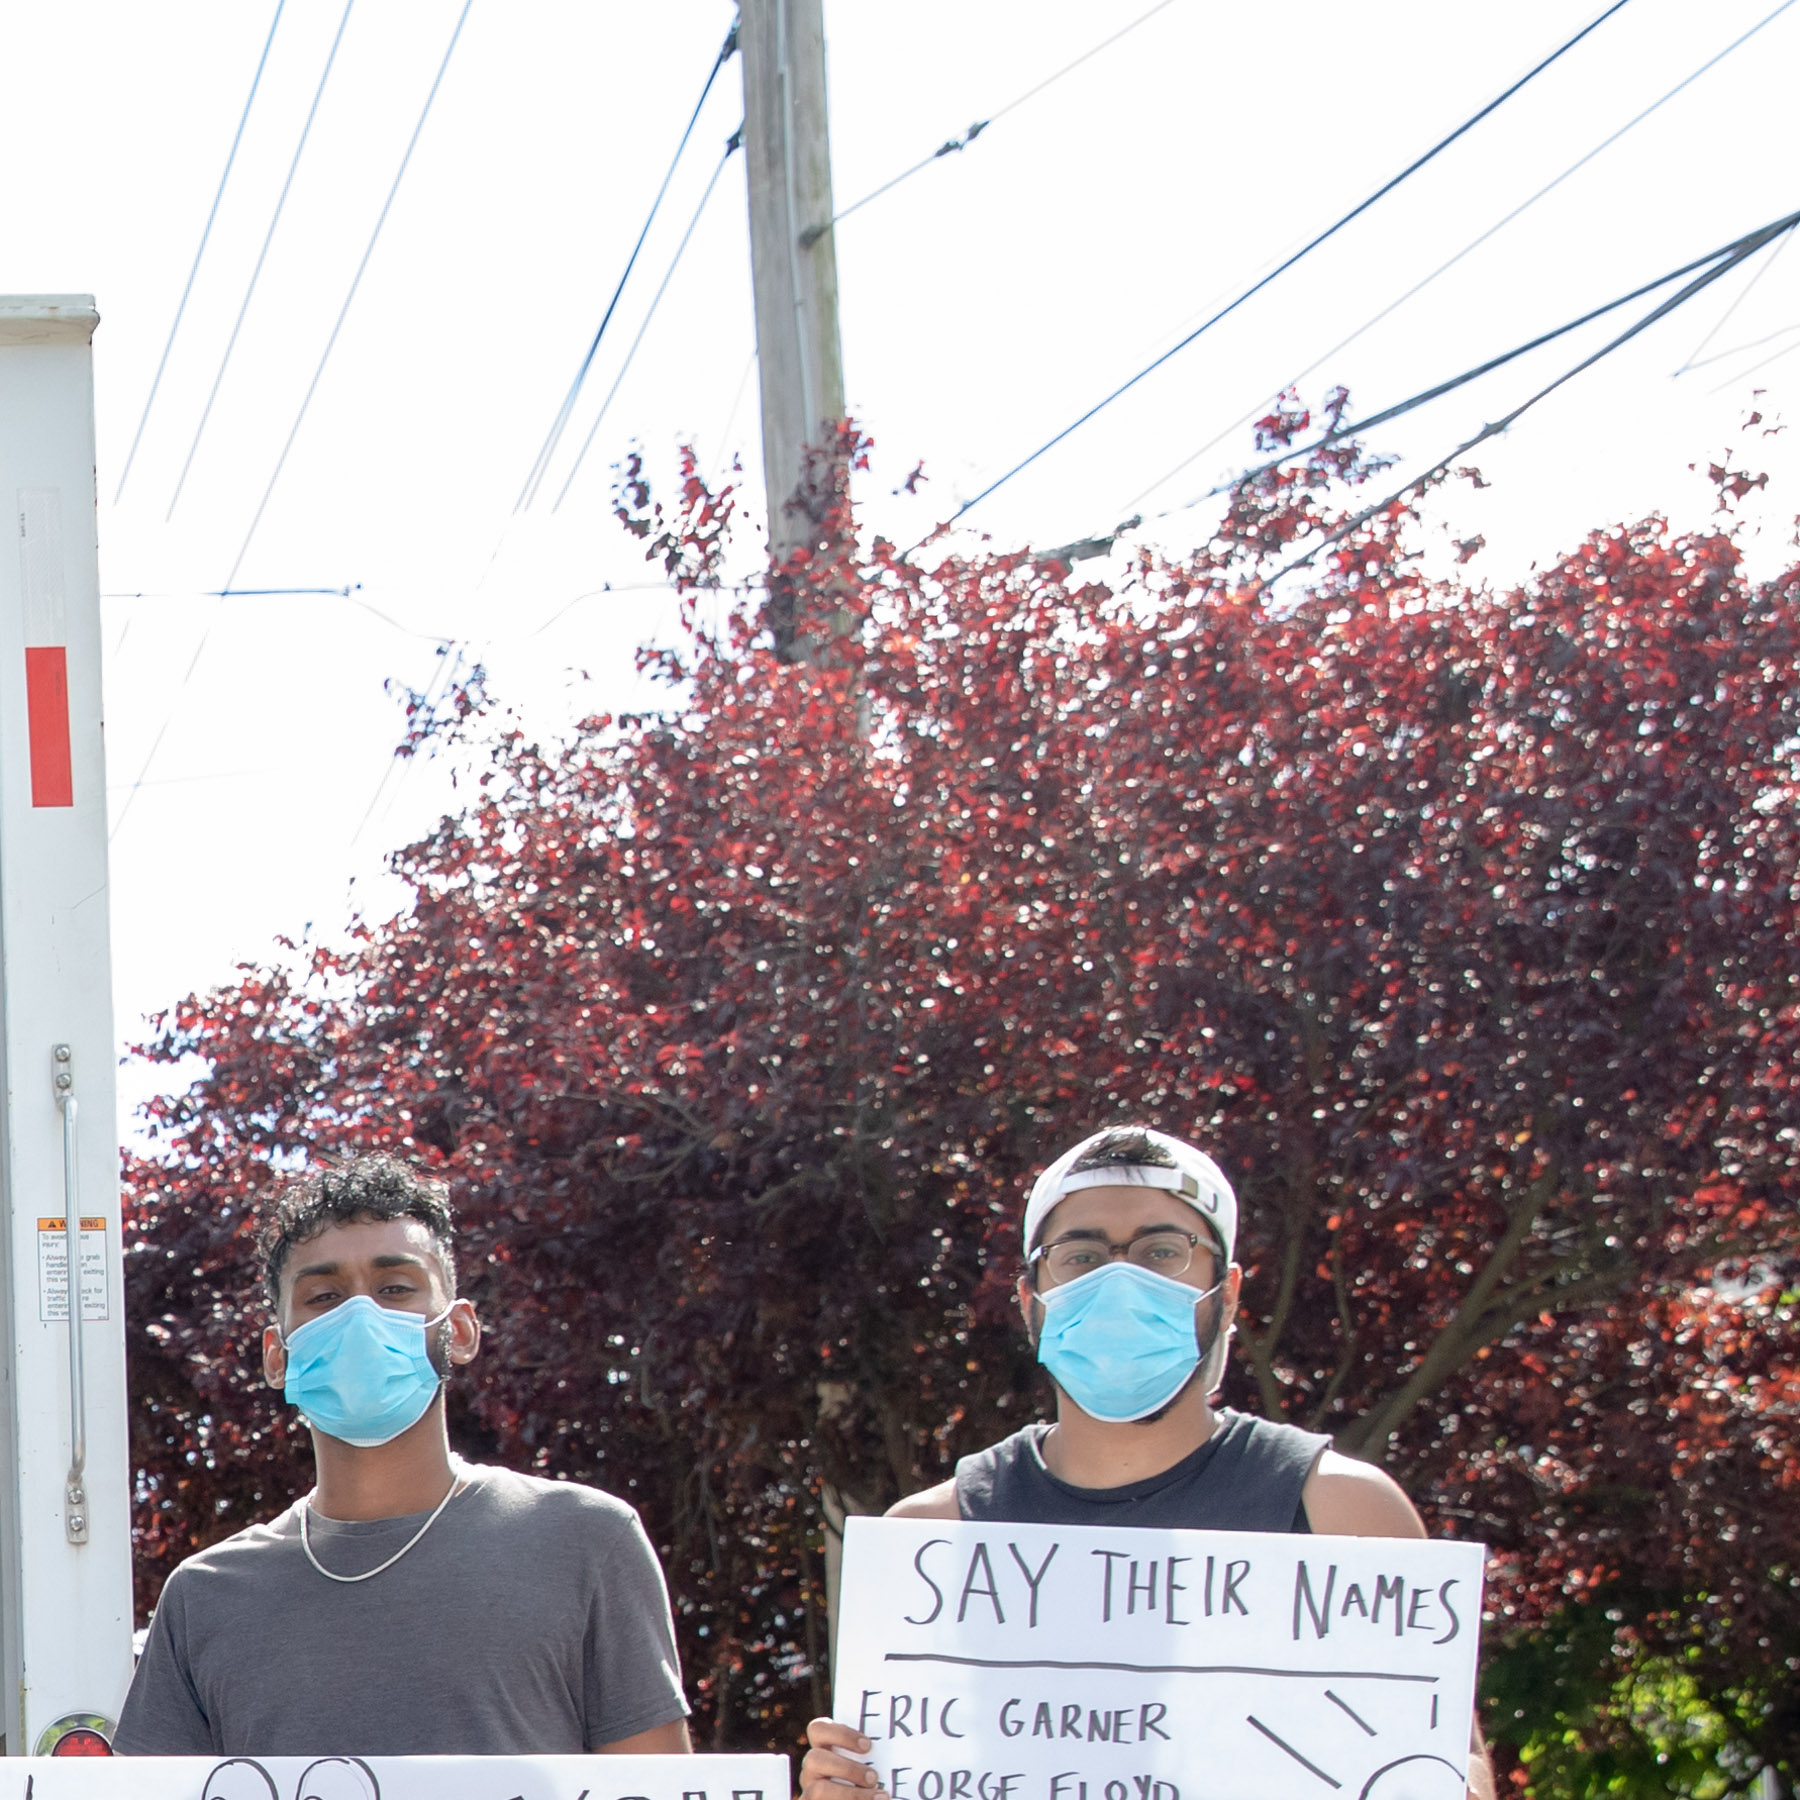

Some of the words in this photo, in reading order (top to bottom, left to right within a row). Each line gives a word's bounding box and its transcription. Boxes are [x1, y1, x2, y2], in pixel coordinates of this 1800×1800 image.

[903, 1538, 1059, 1629] SAY
[1091, 1549, 1251, 1625] THEIR
[859, 1689, 966, 1742] ERIC
[1000, 1699, 1171, 1745] GARNER
